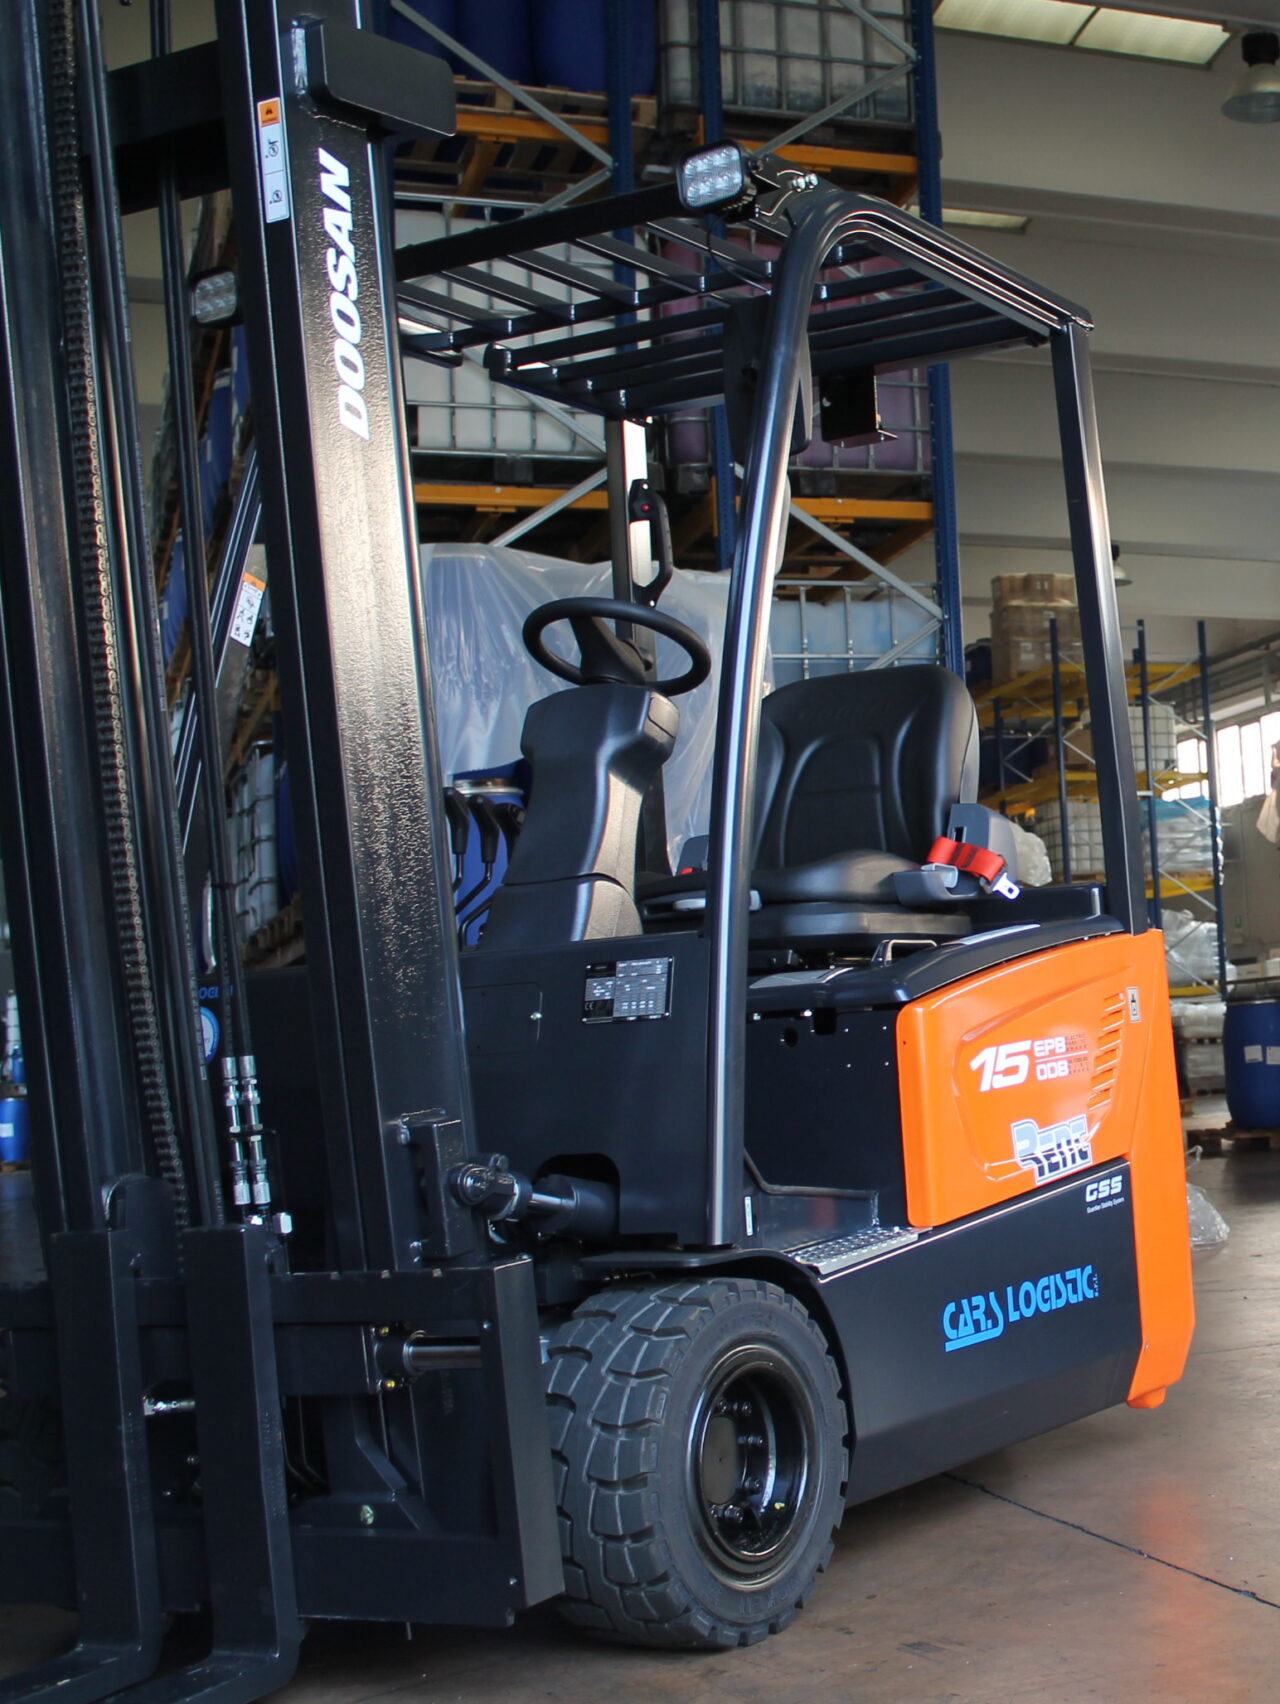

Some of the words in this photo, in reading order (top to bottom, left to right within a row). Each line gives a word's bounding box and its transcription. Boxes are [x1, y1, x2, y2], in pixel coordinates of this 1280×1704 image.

[318, 147, 370, 440] DOOSAN
[969, 1040, 1032, 1092] 15
[1033, 1036, 1066, 1057] EPB
[1036, 1059, 1069, 1081] ODB
[1085, 1175, 1123, 1202] GSS
[1007, 1264, 1094, 1322] LOGISTIC
